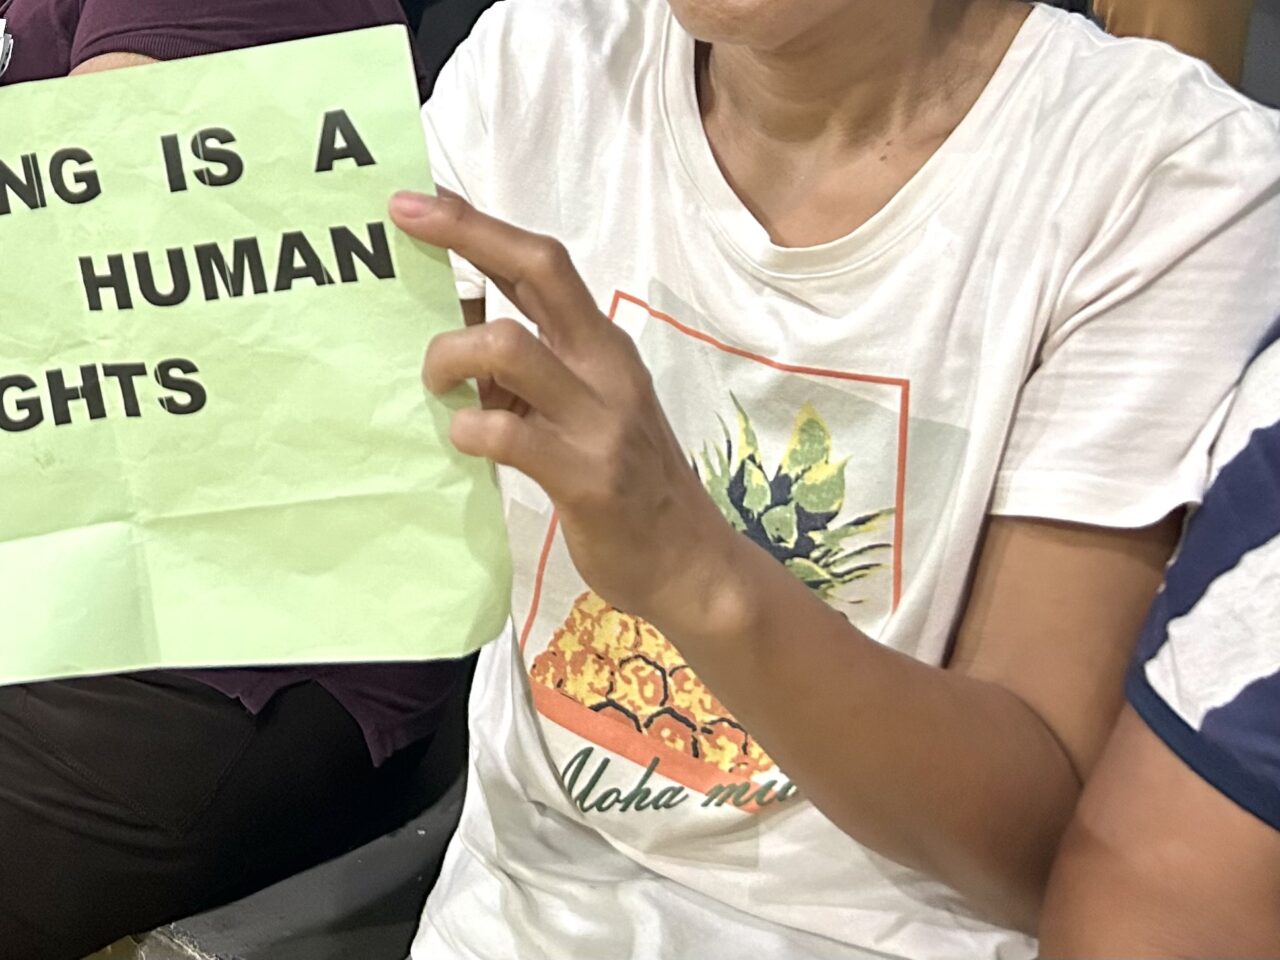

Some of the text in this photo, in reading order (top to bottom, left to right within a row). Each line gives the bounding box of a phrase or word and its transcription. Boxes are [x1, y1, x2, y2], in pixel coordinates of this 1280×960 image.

[159, 126, 245, 193] IS
[314, 107, 377, 173] A
[77, 220, 397, 312] HUMAN
